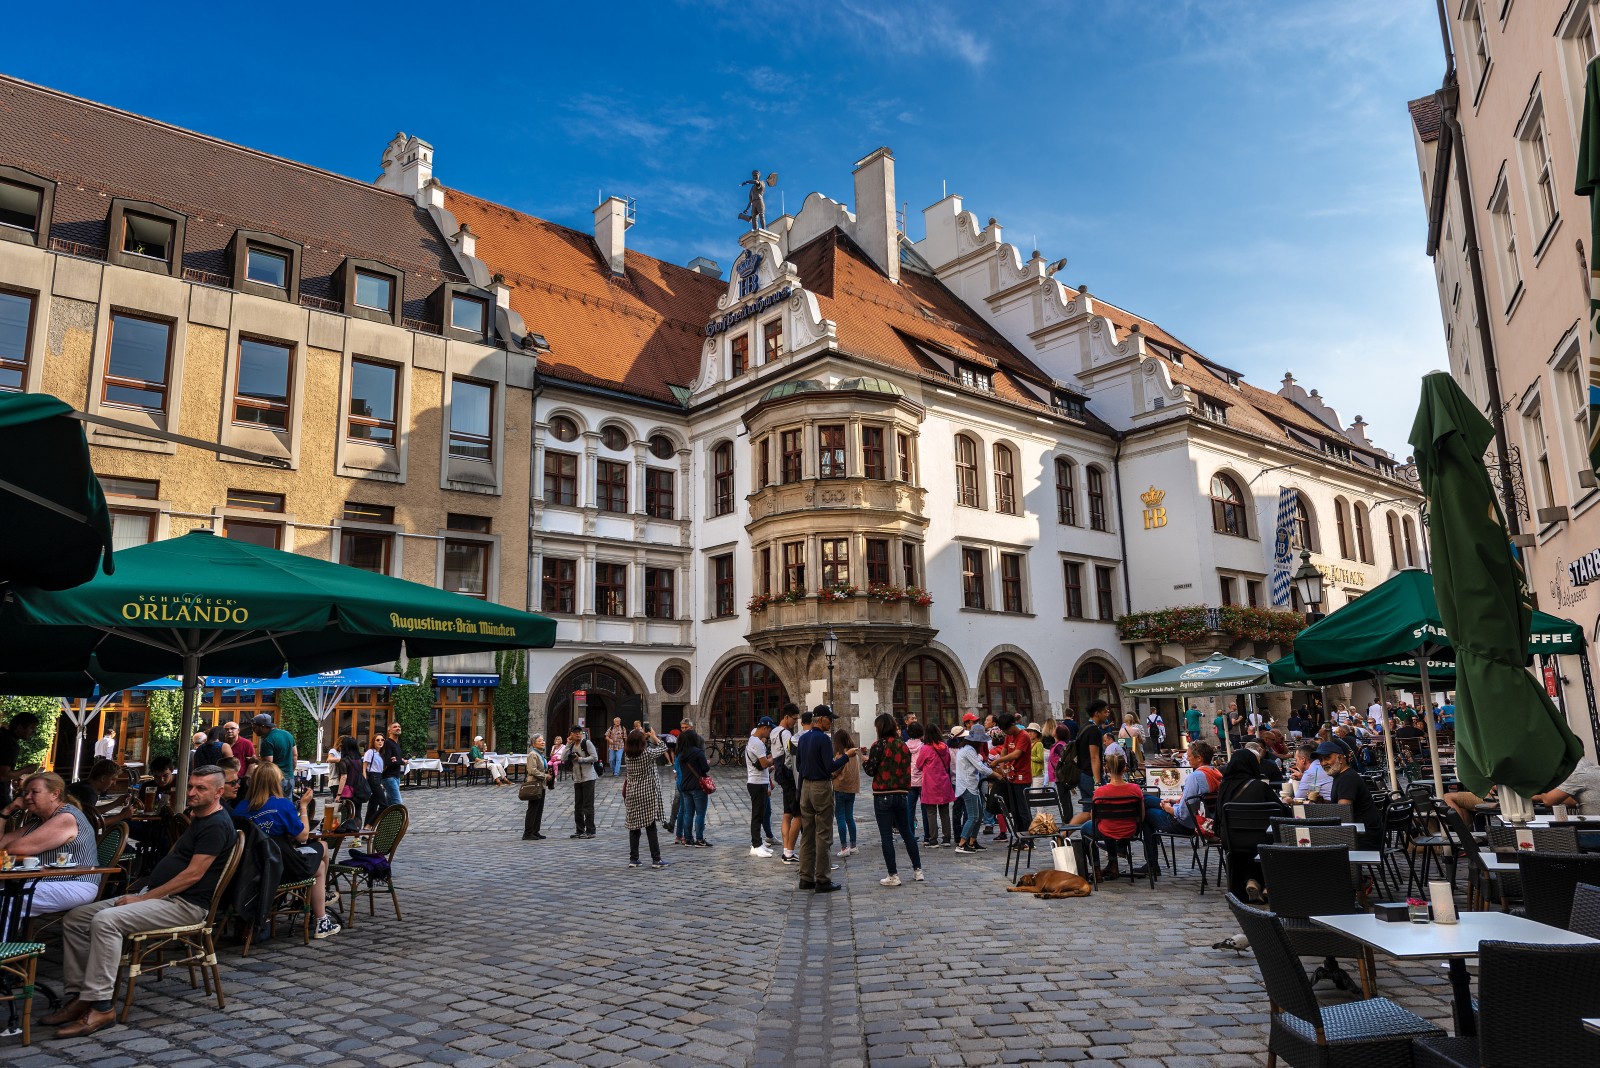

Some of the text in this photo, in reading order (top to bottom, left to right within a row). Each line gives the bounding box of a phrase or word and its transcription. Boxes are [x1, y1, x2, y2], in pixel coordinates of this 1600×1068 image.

[1143, 507, 1168, 529] HB
[122, 602, 249, 623] ORLANDO
[478, 621, 516, 636] München
[1413, 624, 1447, 638] STAR
[1180, 681, 1204, 689] Ayinger
